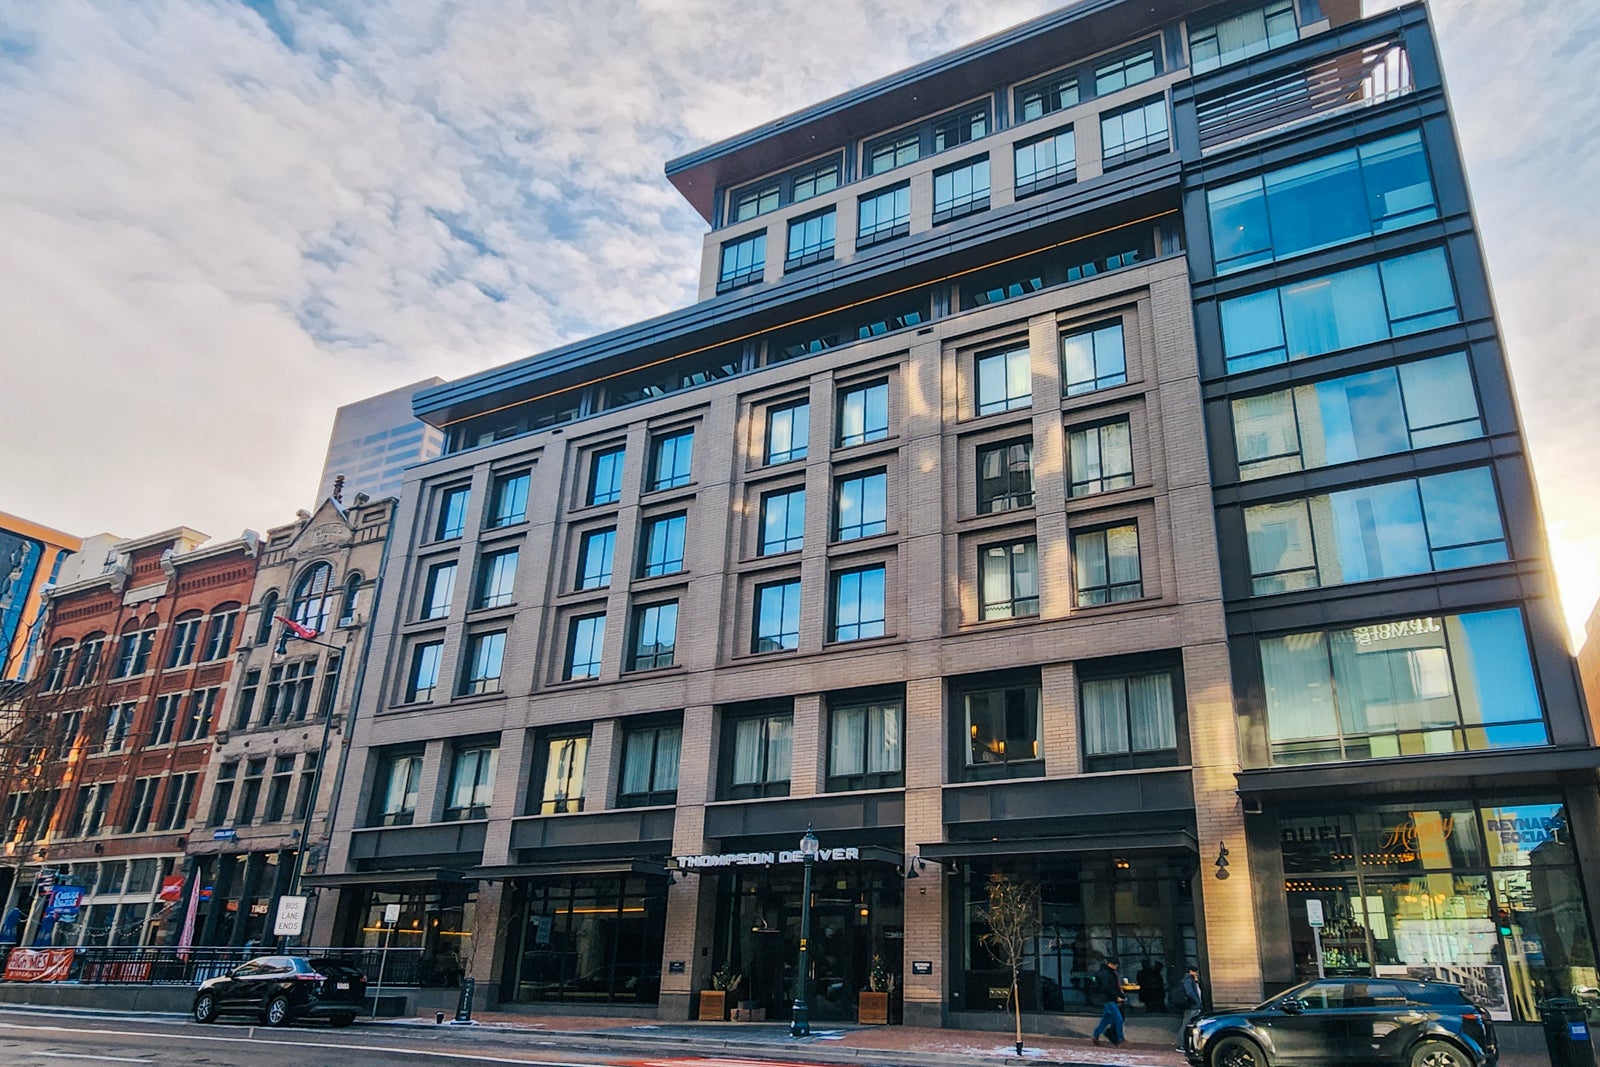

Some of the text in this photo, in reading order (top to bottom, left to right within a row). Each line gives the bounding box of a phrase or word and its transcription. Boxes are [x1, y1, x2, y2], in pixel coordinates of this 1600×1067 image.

[676, 852, 775, 868] THOMPSON
[285, 902, 299, 910] BUS
[281, 912, 299, 920] LANE
[278, 922, 299, 930] ENDS
